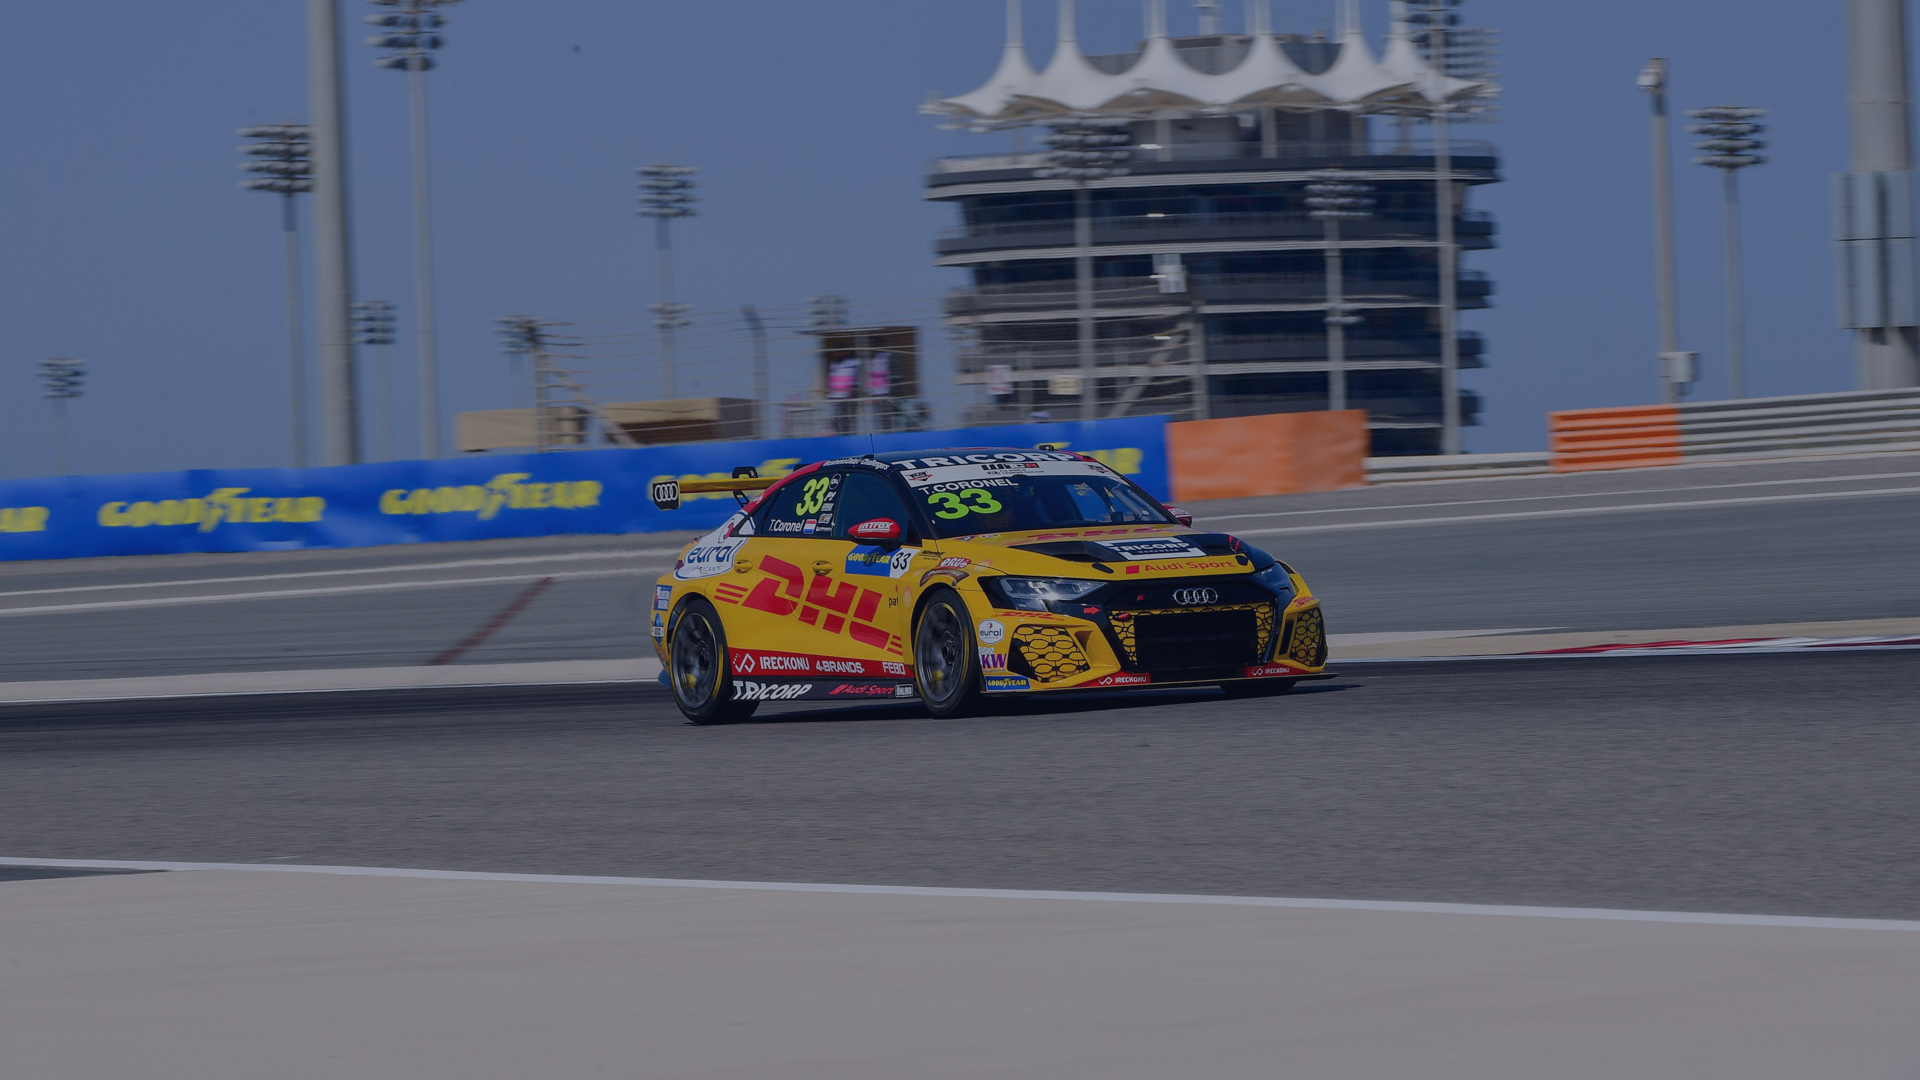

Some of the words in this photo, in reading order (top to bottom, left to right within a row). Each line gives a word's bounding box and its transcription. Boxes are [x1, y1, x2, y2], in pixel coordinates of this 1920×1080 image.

[891, 453, 1074, 469] TRICORP
[918, 478, 1019, 495] T.CORONEL
[796, 477, 830, 516] 33
[927, 488, 1002, 519] 33
[769, 519, 805, 532] T.Coronel
[687, 540, 743, 564] eurol
[1108, 542, 1190, 552] TRICORP
[892, 552, 912, 570] 33
[1145, 562, 1183, 572] Audi
[1188, 560, 1236, 570] Sport
[741, 554, 890, 649] DHL
[979, 628, 1002, 637] eurol
[759, 656, 810, 671] IRECKONU
[981, 653, 1007, 669] KW
[1115, 675, 1147, 683] IRECKONU
[731, 681, 813, 700] TRICORP
